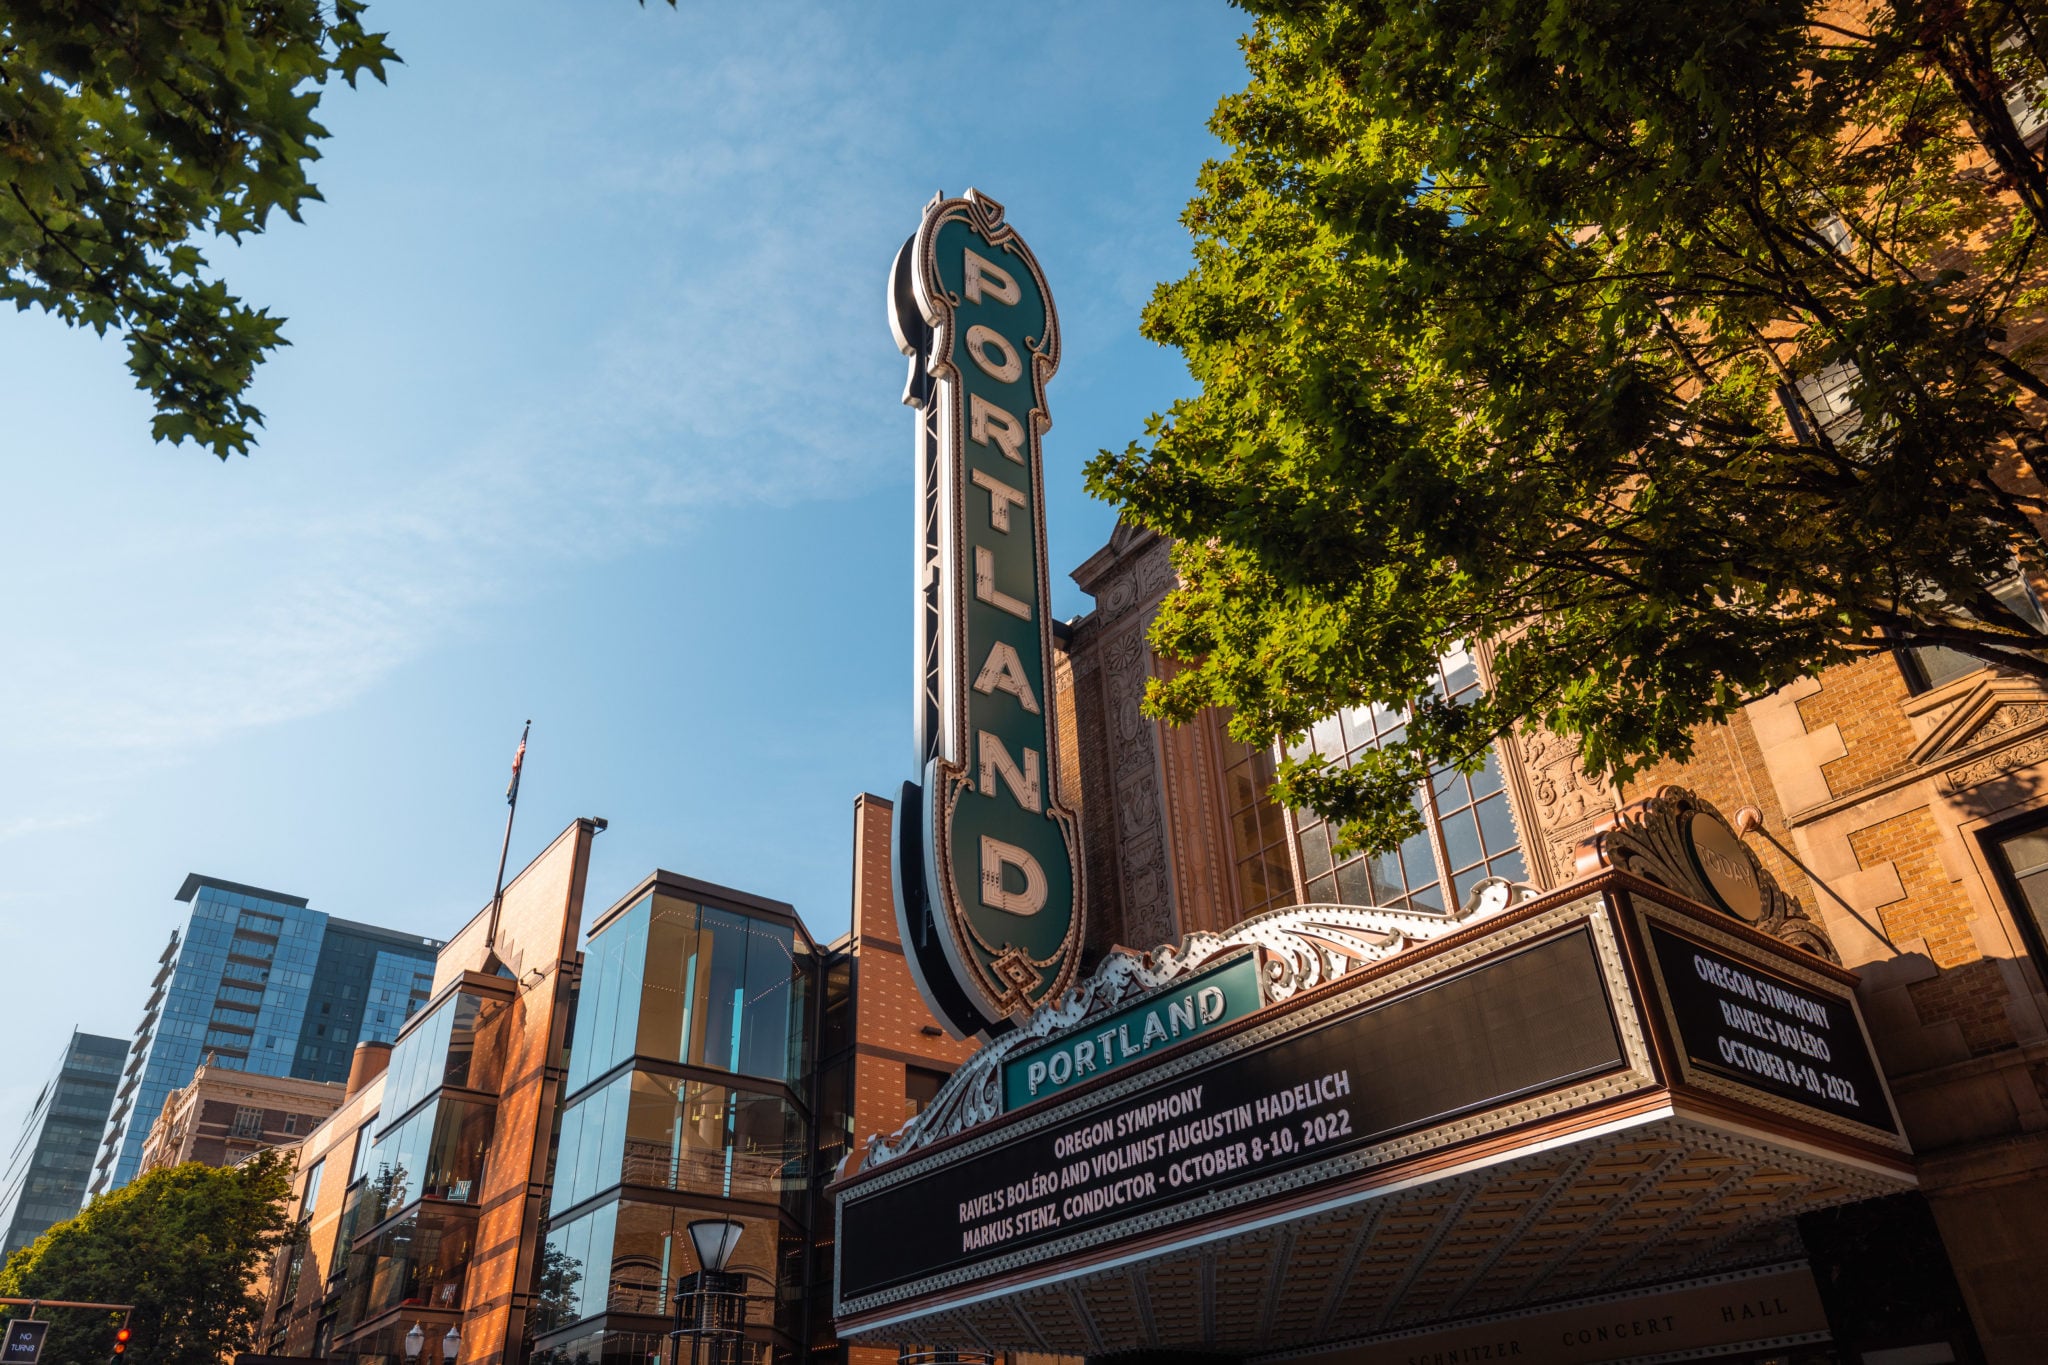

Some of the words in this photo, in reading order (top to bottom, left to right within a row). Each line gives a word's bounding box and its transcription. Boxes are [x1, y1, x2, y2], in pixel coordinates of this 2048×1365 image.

[963, 247, 1048, 917] PORTLAND
[1695, 841, 1754, 889] TODAY
[1694, 954, 1758, 1001] OREGON
[1755, 980, 1830, 1030] SYMPHONY
[1028, 986, 1225, 1095] PORTLAND
[1719, 999, 1778, 1043] RAVEL'S
[1774, 1021, 1831, 1063] BOLÉRO
[1718, 1035, 1790, 1084] OCTOBER
[1786, 1060, 1826, 1099] 8-10,
[1822, 1073, 1860, 1107] 2022
[959, 1188, 1005, 1224] RAVEL'S
[1007, 1171, 1058, 1208] BOLÉRO
[1061, 1160, 1090, 1190] AND
[1092, 1133, 1165, 1177] VIOLINIST
[1168, 1103, 1253, 1154] AUGUSTIN
[1255, 1069, 1350, 1124] HADELICH
[1054, 1118, 1114, 1160] OREGON
[1117, 1085, 1203, 1138] SYMPHONY
[963, 1216, 1014, 1253] MARKUS
[1016, 1202, 1061, 1236] STENZ,
[1063, 1171, 1157, 1220] CONDUCTOR
[1169, 1142, 1250, 1188] OCTOBER
[1251, 1127, 1300, 1162] 8-10,
[1302, 1108, 1352, 1147] 2022
[20, 1332, 32, 1340] NO
[1561, 1315, 1676, 1347] CONCERT
[1721, 1298, 1788, 1322] HALL
